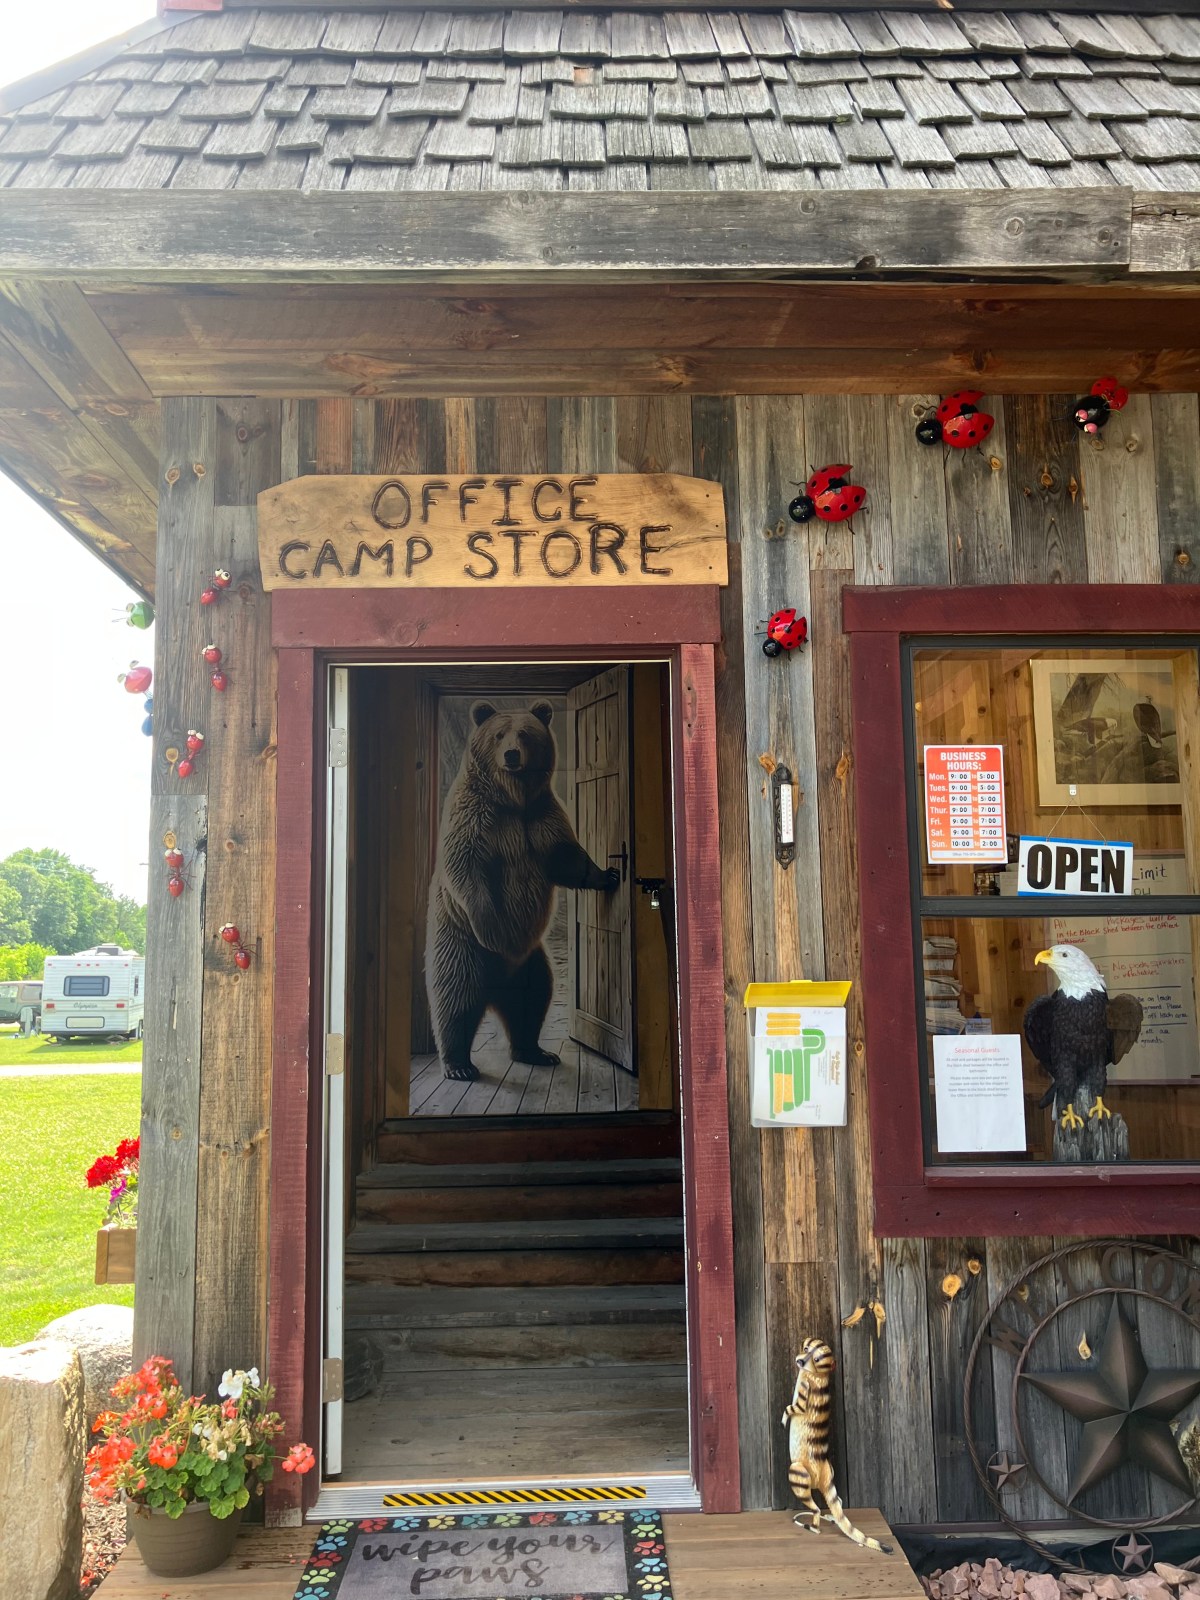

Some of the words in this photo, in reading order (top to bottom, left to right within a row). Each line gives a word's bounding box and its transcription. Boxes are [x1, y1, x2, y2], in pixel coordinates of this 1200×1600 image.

[371, 477, 599, 530] OFFICE
[278, 537, 433, 579] CAMP
[464, 523, 674, 579] STORE
[940, 752, 987, 761] BUSINESS
[947, 761, 982, 771] HOURS:
[929, 773, 948, 781] Mon.
[929, 784, 949, 792] Tues.
[930, 795, 948, 803] Wed.
[930, 806, 948, 814] Thur.
[931, 829, 945, 837] Sat.
[931, 840, 948, 848] Sun.
[1026, 843, 1125, 894] OPEN
[361, 1533, 483, 1562] wipe
[486, 1530, 615, 1564] your
[409, 1558, 551, 1596] paws
